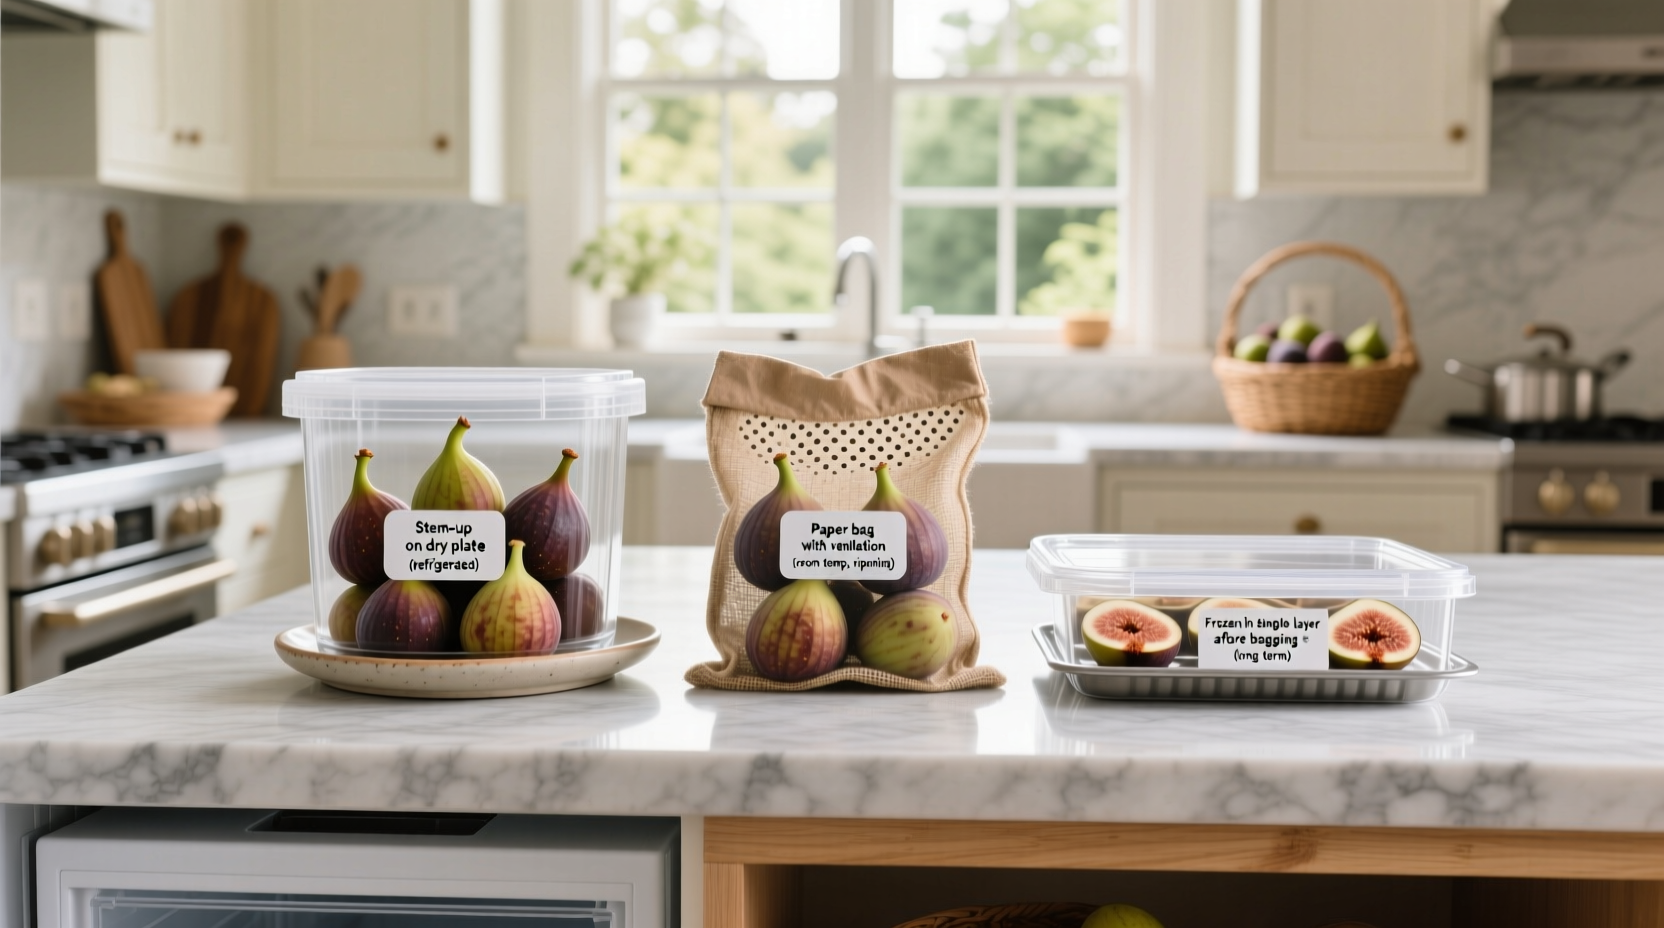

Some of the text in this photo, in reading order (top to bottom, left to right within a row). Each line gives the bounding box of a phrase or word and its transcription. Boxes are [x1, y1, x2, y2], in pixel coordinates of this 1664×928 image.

[416, 520, 472, 537] Stem-up
[811, 522, 874, 538] Paper bag
[405, 538, 486, 555] on dry plate
[801, 539, 826, 551] with
[1293, 616, 1320, 631] layer
[1250, 632, 1298, 648] bagging
[1262, 650, 1291, 662] term)
